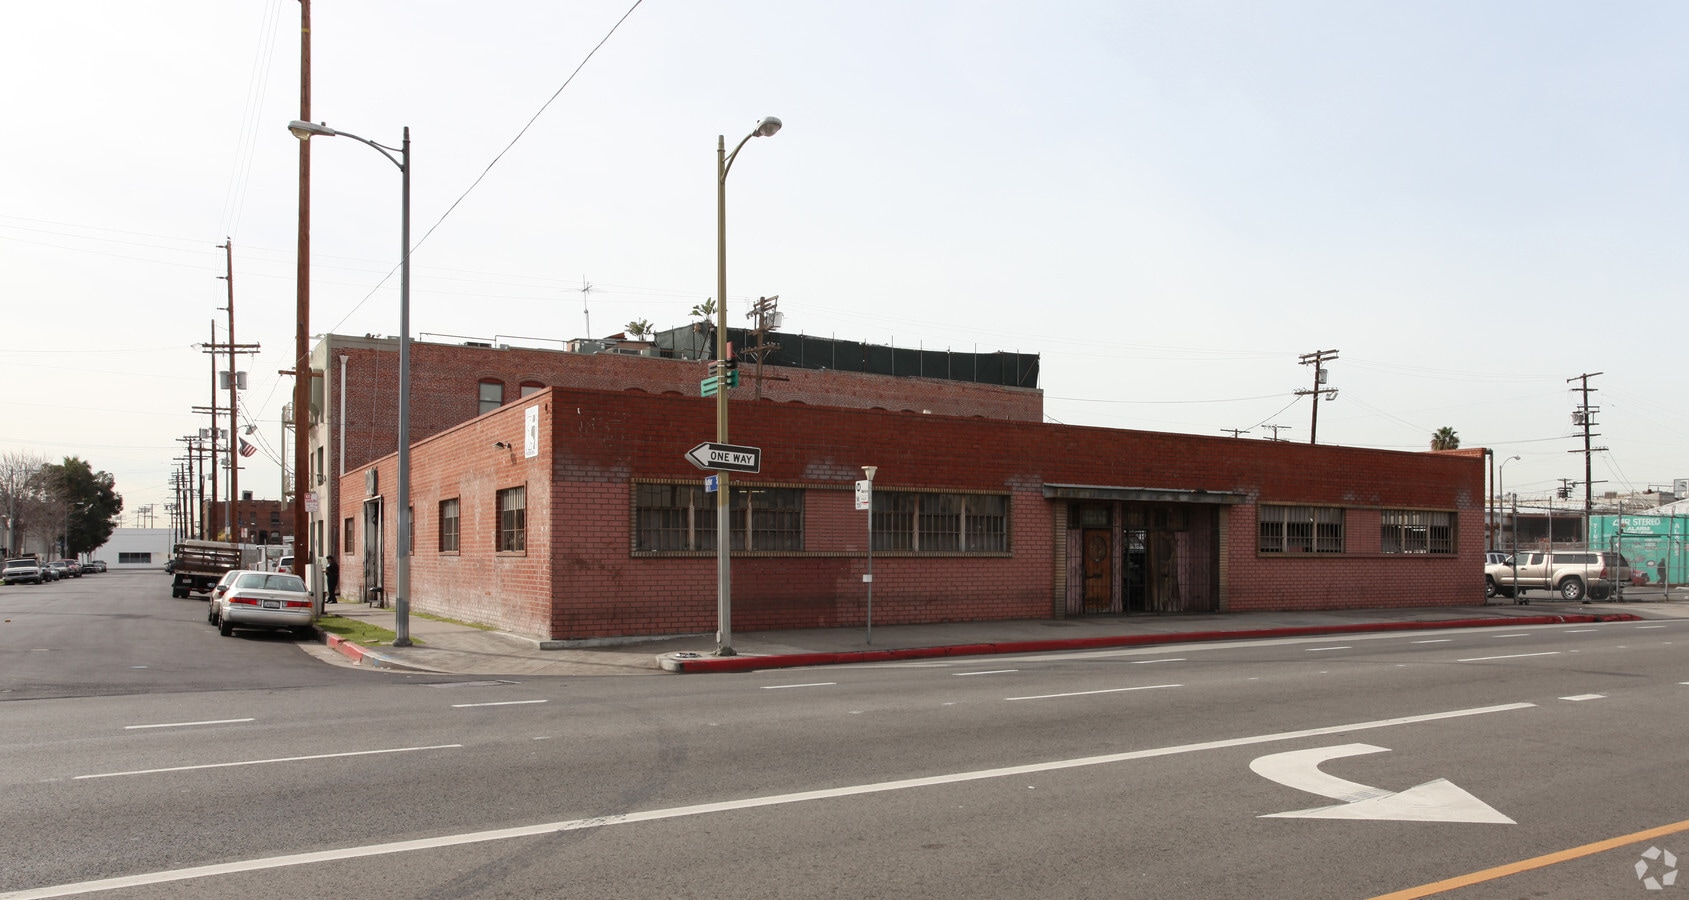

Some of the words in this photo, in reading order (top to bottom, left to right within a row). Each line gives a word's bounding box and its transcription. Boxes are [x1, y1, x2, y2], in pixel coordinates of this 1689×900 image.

[710, 451, 730, 462] ONE
[733, 453, 753, 464] WAY
[1632, 518, 1661, 526] STEREO
